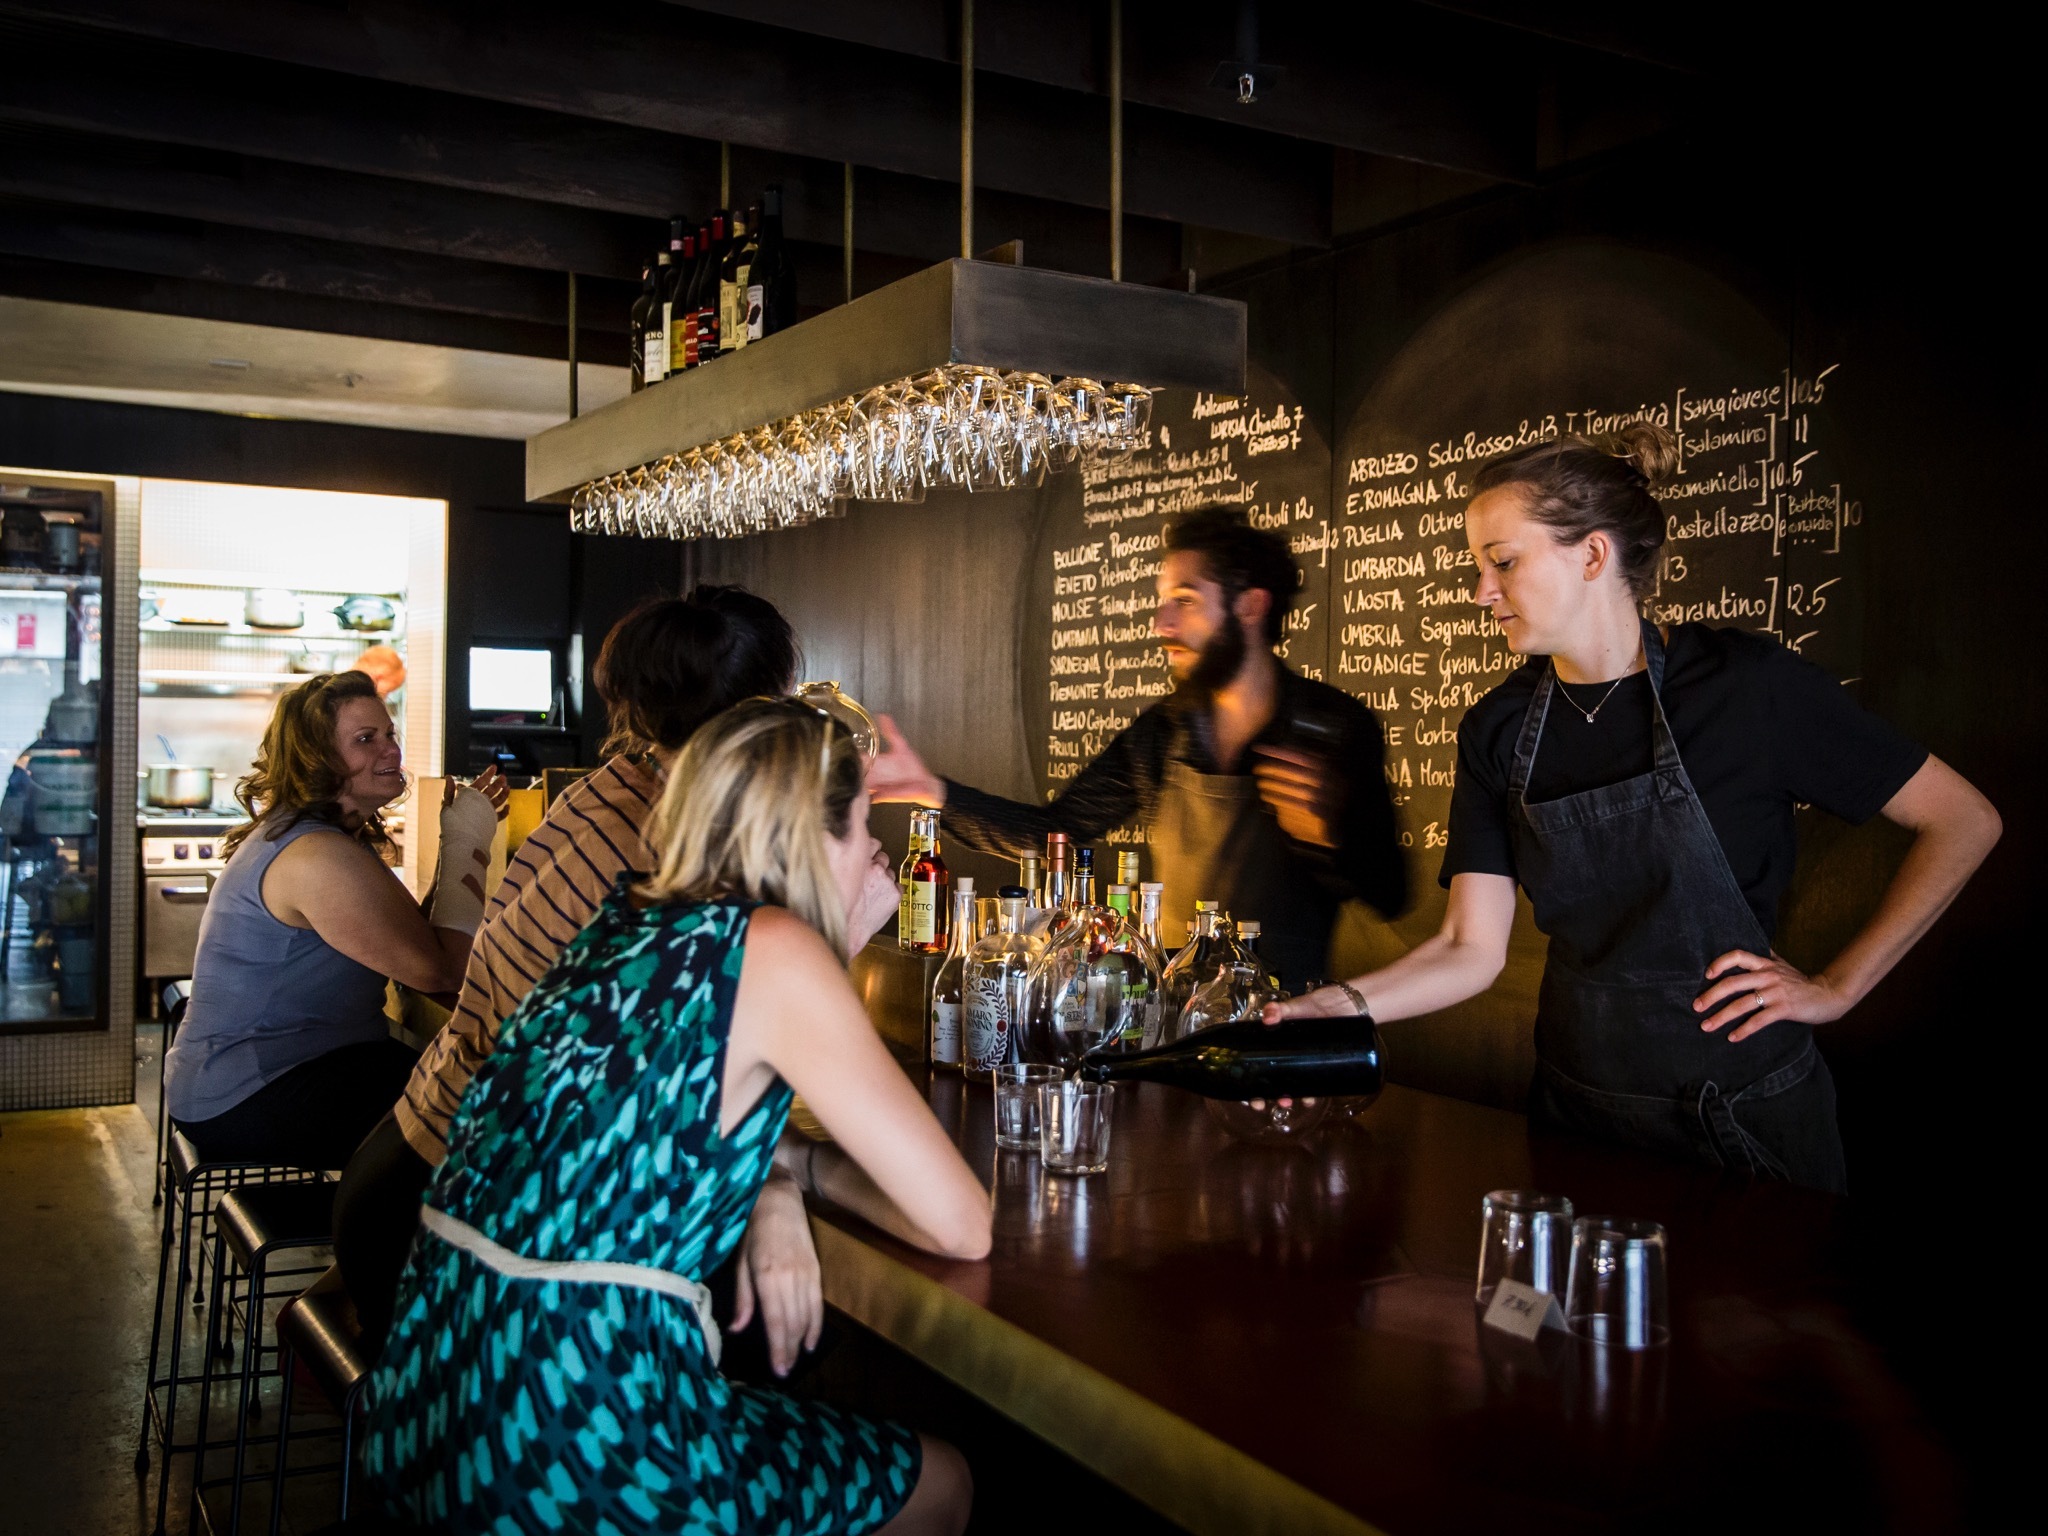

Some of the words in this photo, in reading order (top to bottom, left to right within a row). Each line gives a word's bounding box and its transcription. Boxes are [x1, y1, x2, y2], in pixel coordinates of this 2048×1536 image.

[1294, 406, 1304, 429] 7
[1289, 430, 1302, 450] 7
[1349, 453, 1418, 485] ABRUZZO
[1295, 496, 1313, 521] 12
[1343, 520, 1404, 548] PUGLIA
[1418, 511, 1464, 538] Oltre
[1109, 532, 1160, 558] Prosecco
[1344, 552, 1426, 583] LOMBARDIA
[1433, 546, 1475, 571] Pezz
[1664, 555, 1688, 582] 13
[1055, 574, 1097, 595] VENETO
[1052, 597, 1097, 623] MOLISE
[1341, 623, 1404, 648] UMBRIA
[1421, 610, 1507, 646] Sagrantin
[1052, 710, 1086, 731] LAZIO
[1420, 758, 1457, 788] Mont
